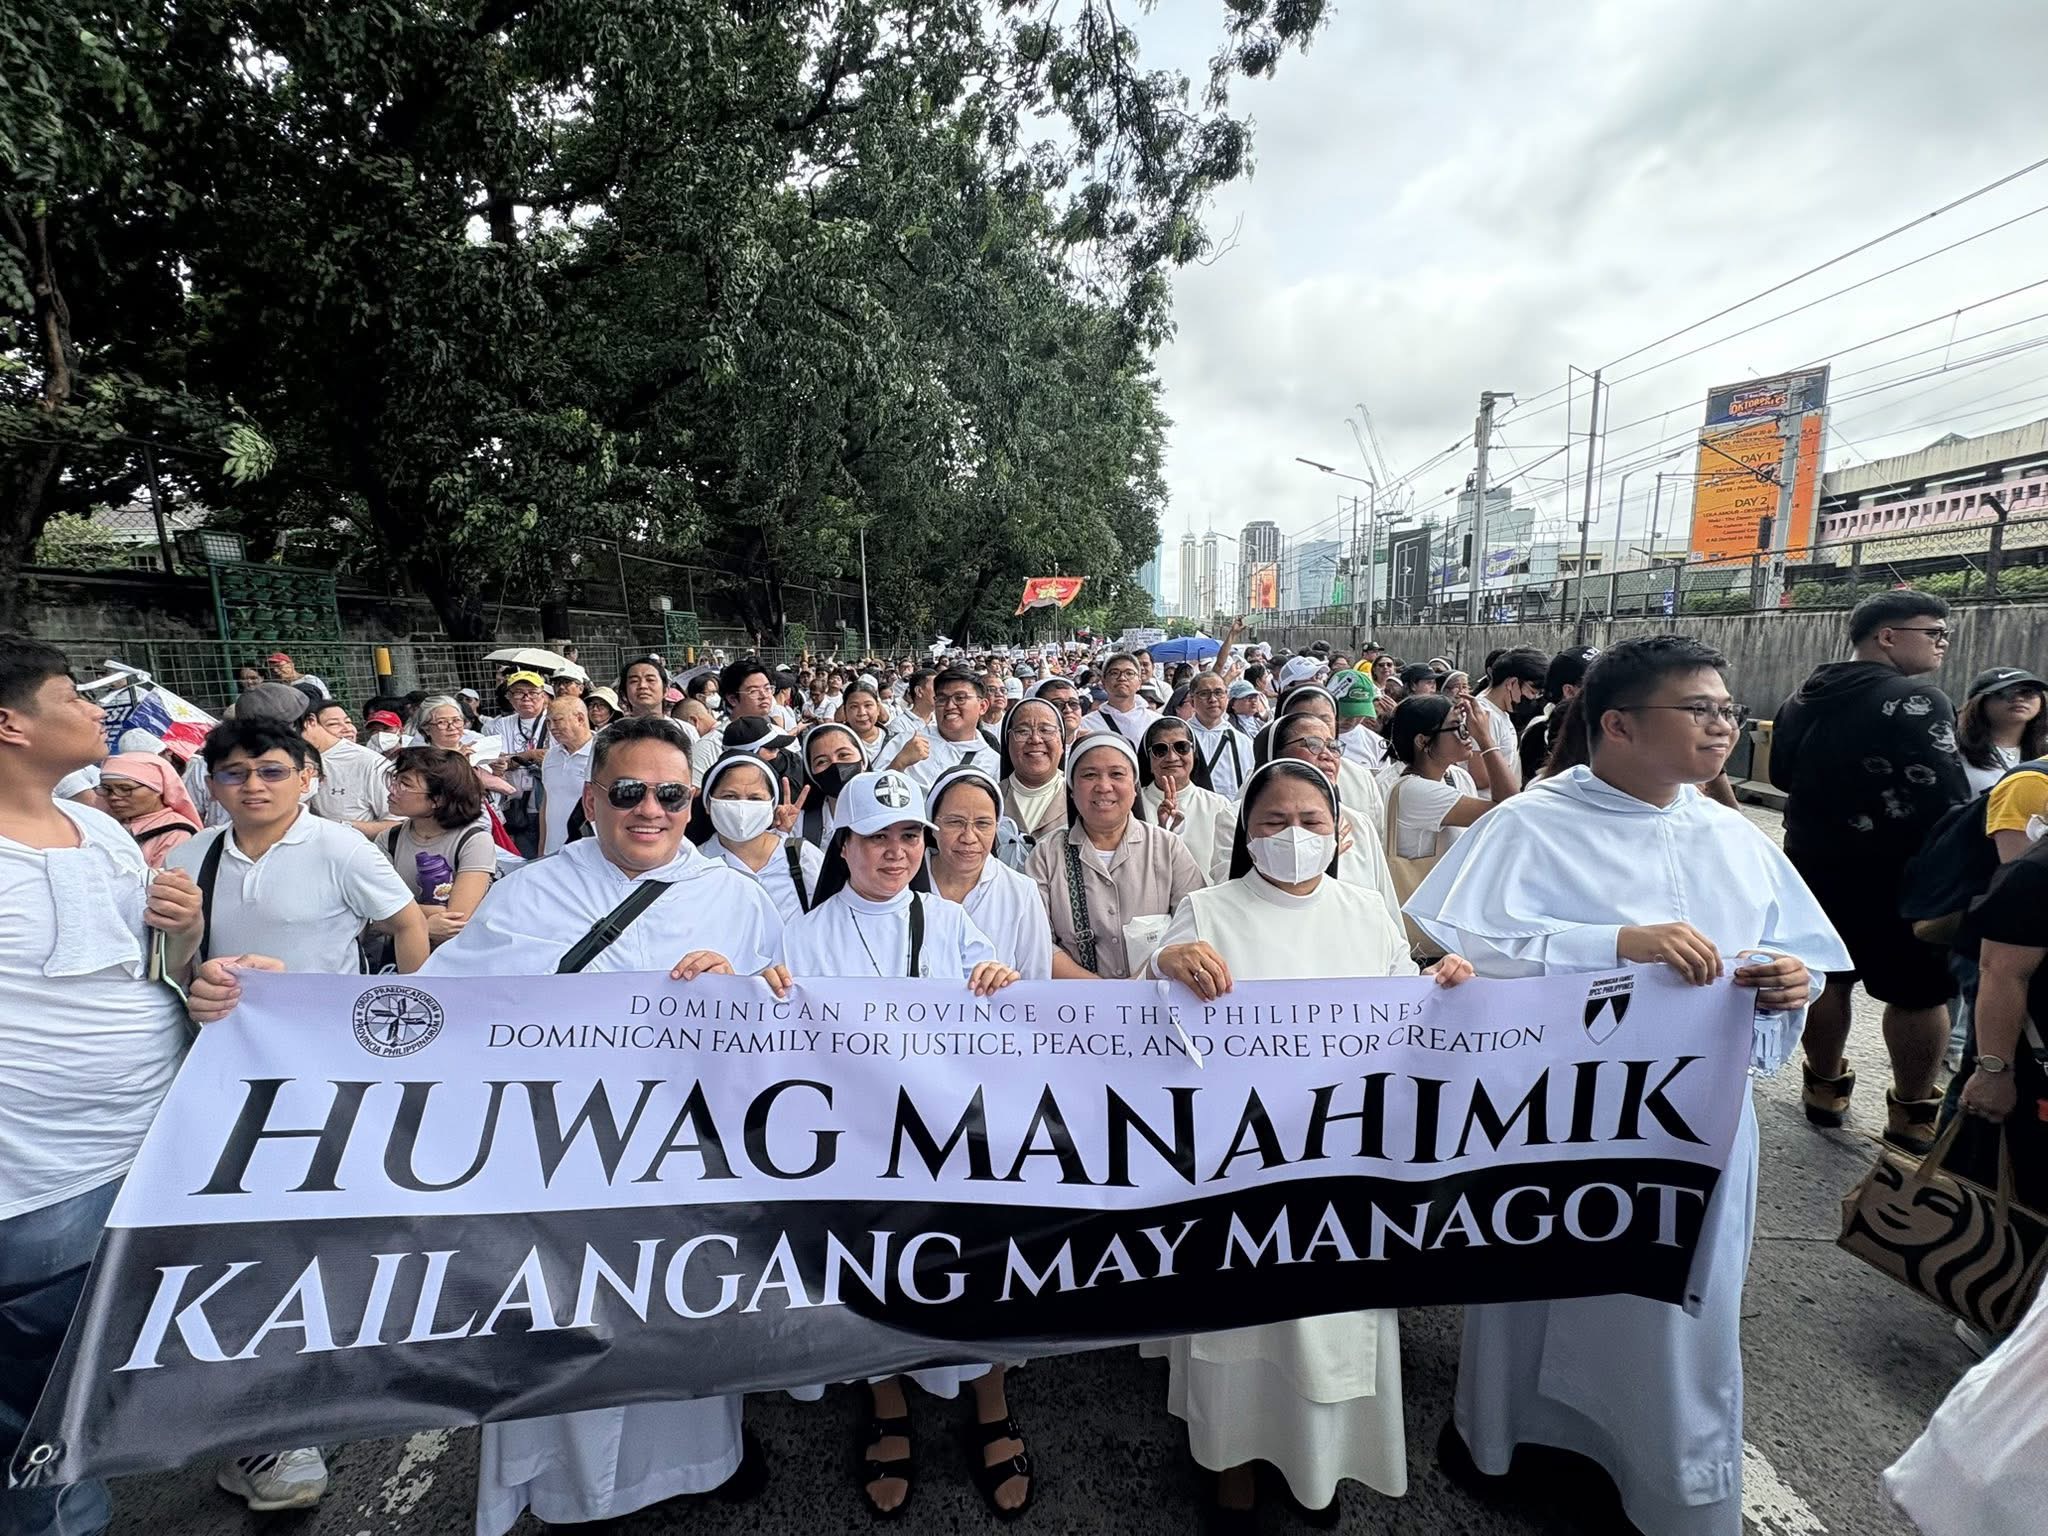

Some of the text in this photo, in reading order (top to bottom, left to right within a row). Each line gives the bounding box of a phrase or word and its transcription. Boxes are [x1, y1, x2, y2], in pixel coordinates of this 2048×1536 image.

[1741, 452, 1772, 463] DAY 1
[1735, 496, 1768, 507] DAY 2
[356, 987, 439, 1012] ORDO PRAEDICATORUM
[1602, 982, 1634, 994] PHILIPPINES
[630, 995, 1425, 1025] DOMINICAN PROVINCE OF THE PHILIPPINES
[355, 1018, 440, 1056] PROVINCIA PHILIPPINARUM
[487, 1023, 1546, 1062] DOMINICAN FAMILY FOR JUSTICE, PEACE, AND CARE FOR CREATION
[188, 1056, 1712, 1197] HUWAG MANAHIMIK
[113, 1181, 1705, 1374] KAILANGANG MAY MANAGOT
